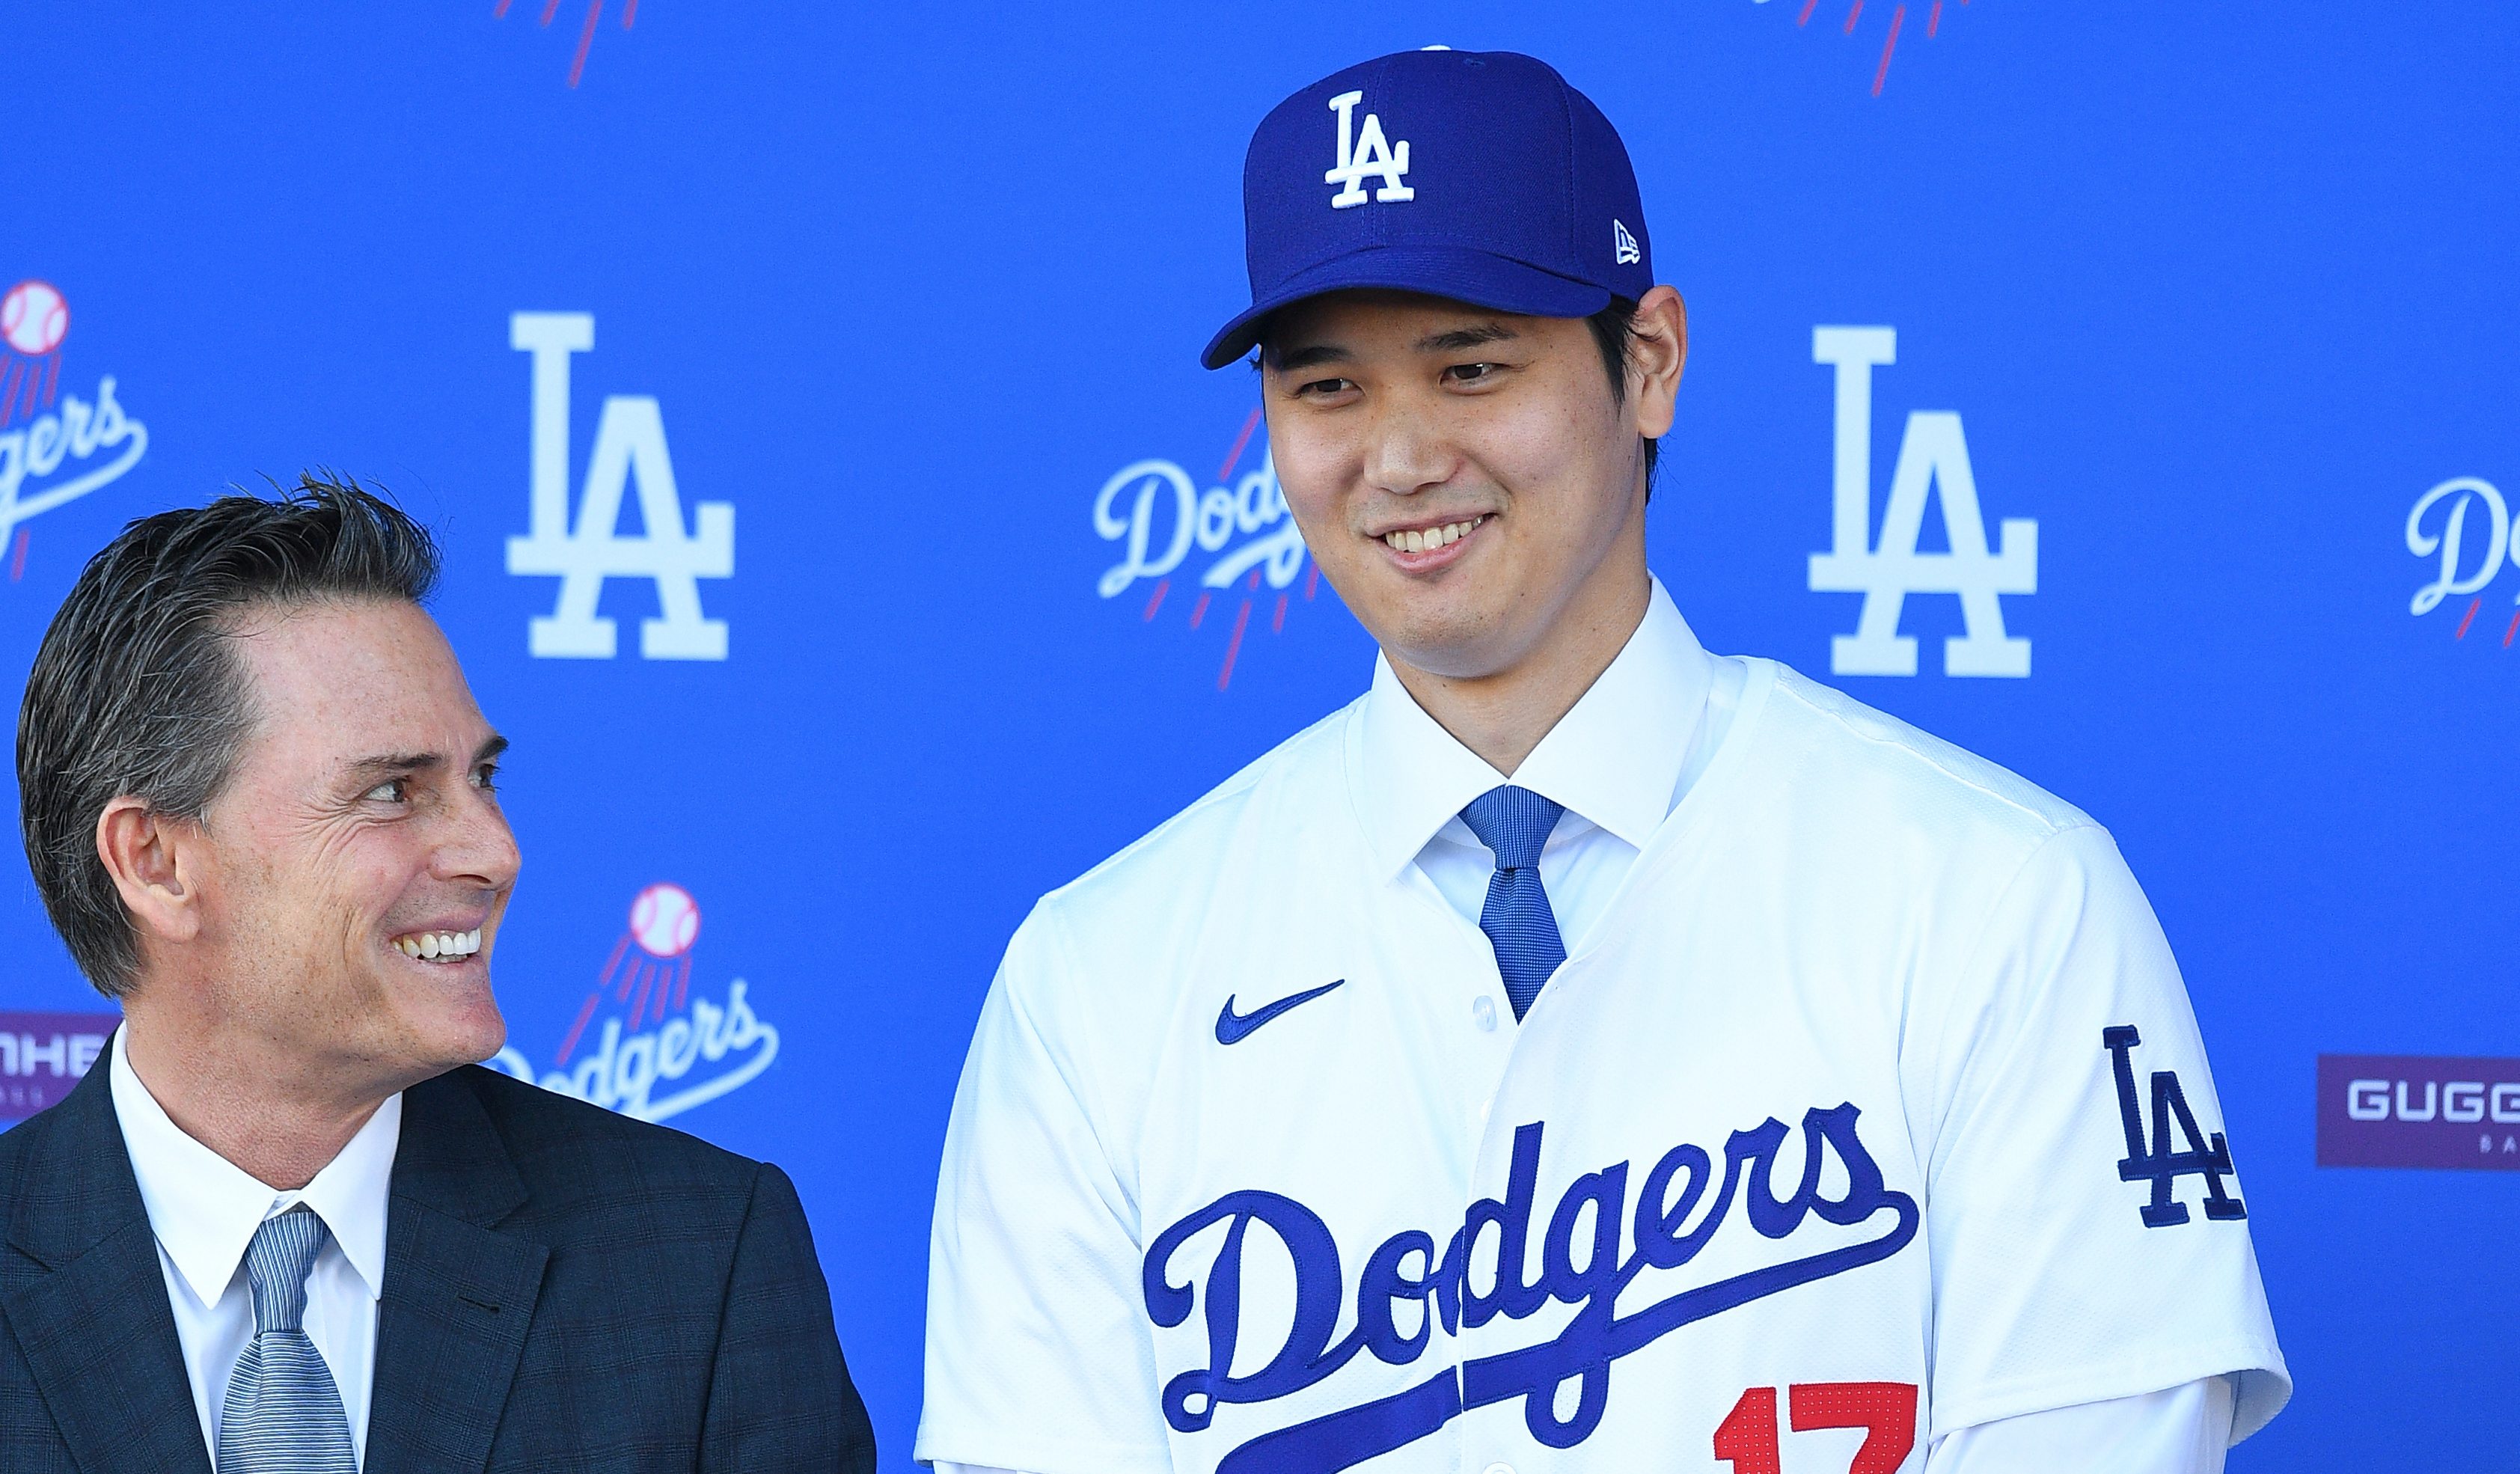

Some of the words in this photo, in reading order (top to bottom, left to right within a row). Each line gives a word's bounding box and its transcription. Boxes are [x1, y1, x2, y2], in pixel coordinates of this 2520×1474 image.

[1324, 90, 1415, 209] LA
[506, 311, 735, 661] LA
[1808, 326, 2039, 679] LA
[483, 976, 780, 1122] dgers
[2102, 1024, 2247, 1228] LA
[1142, 1101, 1919, 1474] Dodgers
